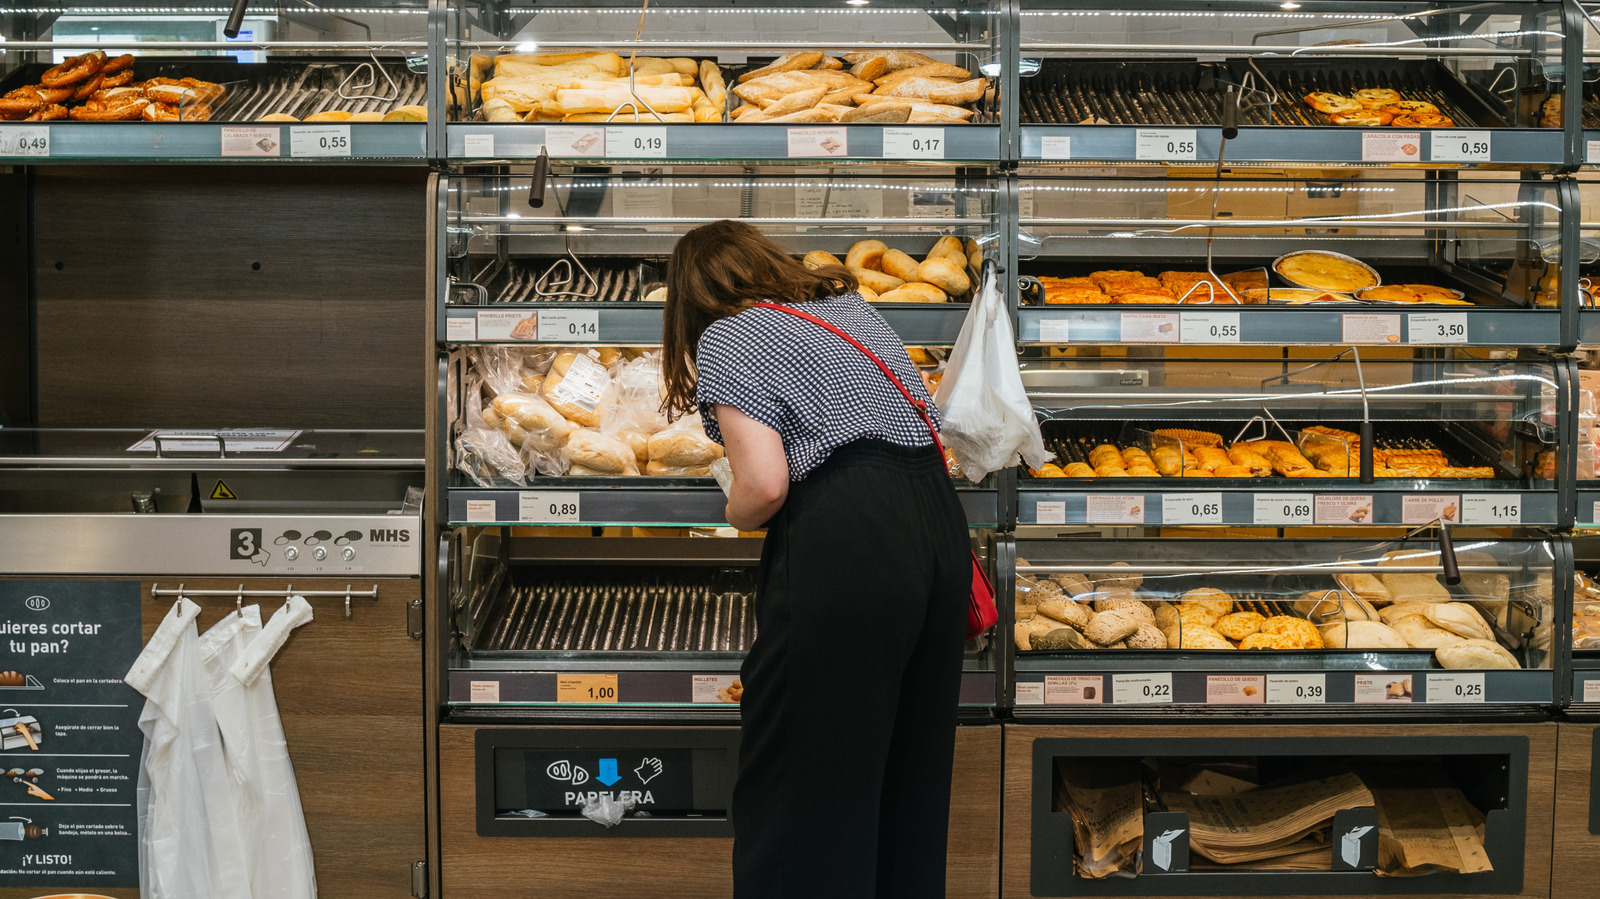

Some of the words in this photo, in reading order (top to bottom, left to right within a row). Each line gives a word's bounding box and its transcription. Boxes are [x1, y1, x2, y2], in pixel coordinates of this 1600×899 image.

[20, 138, 46, 150] 0,49
[320, 137, 346, 150] 0,55
[634, 138, 662, 150] 0,19
[913, 139, 940, 152] 0,17
[1167, 142, 1194, 155] 0,55
[1462, 142, 1488, 155] 0,59
[568, 323, 596, 336] 0,14
[1210, 325, 1236, 338] 0,55
[1438, 324, 1464, 338] 3,50
[549, 503, 577, 516] 0,89
[1192, 504, 1219, 517] 0,65
[1283, 505, 1310, 518] 0,69
[1492, 505, 1518, 518] 1,15
[237, 530, 255, 556] 3
[370, 529, 410, 542] MHS
[52, 622, 102, 635] cortar
[10, 640, 26, 653] tu
[30, 639, 69, 656] pan?
[588, 687, 614, 700] 1,00
[1143, 685, 1169, 698] 0,22
[1296, 686, 1322, 699] 0,39
[1455, 684, 1481, 697] 0,25
[36, 854, 72, 865] LISTO!
